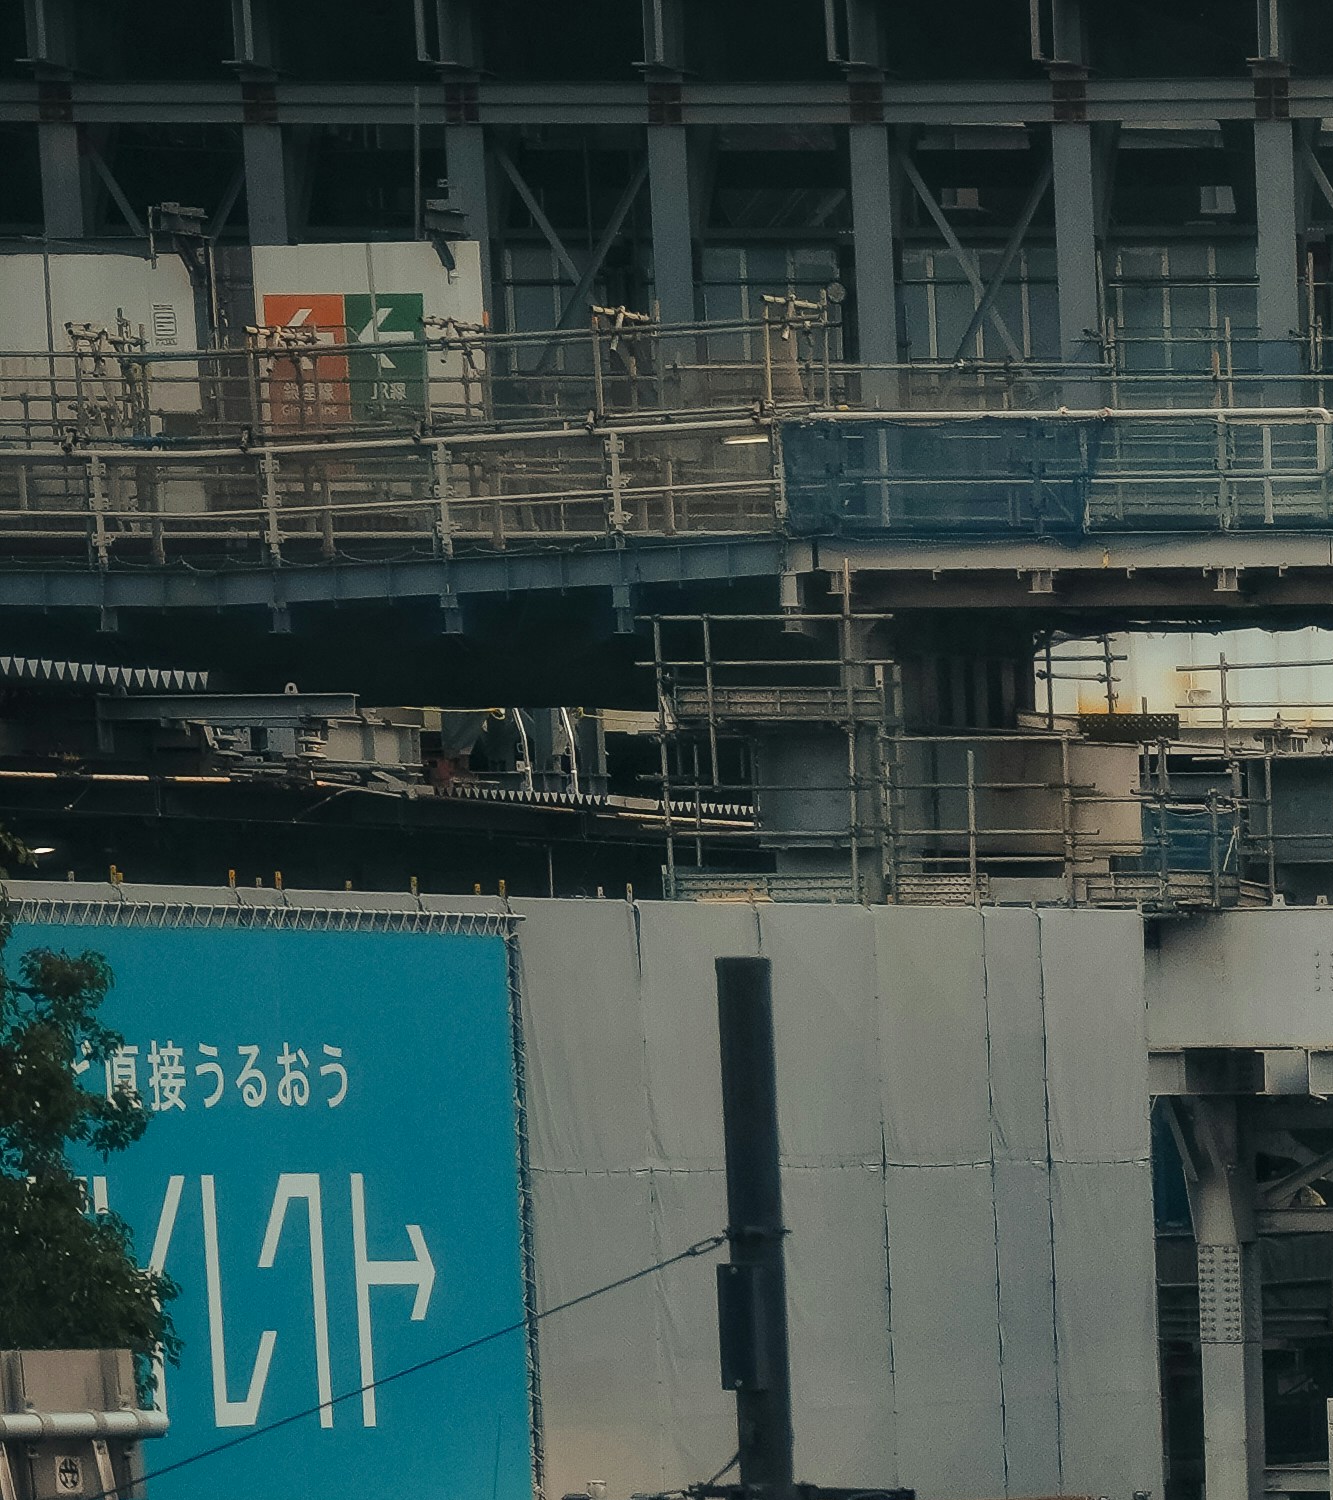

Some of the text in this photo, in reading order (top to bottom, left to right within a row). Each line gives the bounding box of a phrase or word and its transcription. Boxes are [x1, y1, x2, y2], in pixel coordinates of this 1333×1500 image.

[70, 1039, 348, 1111] 直接うるおう
